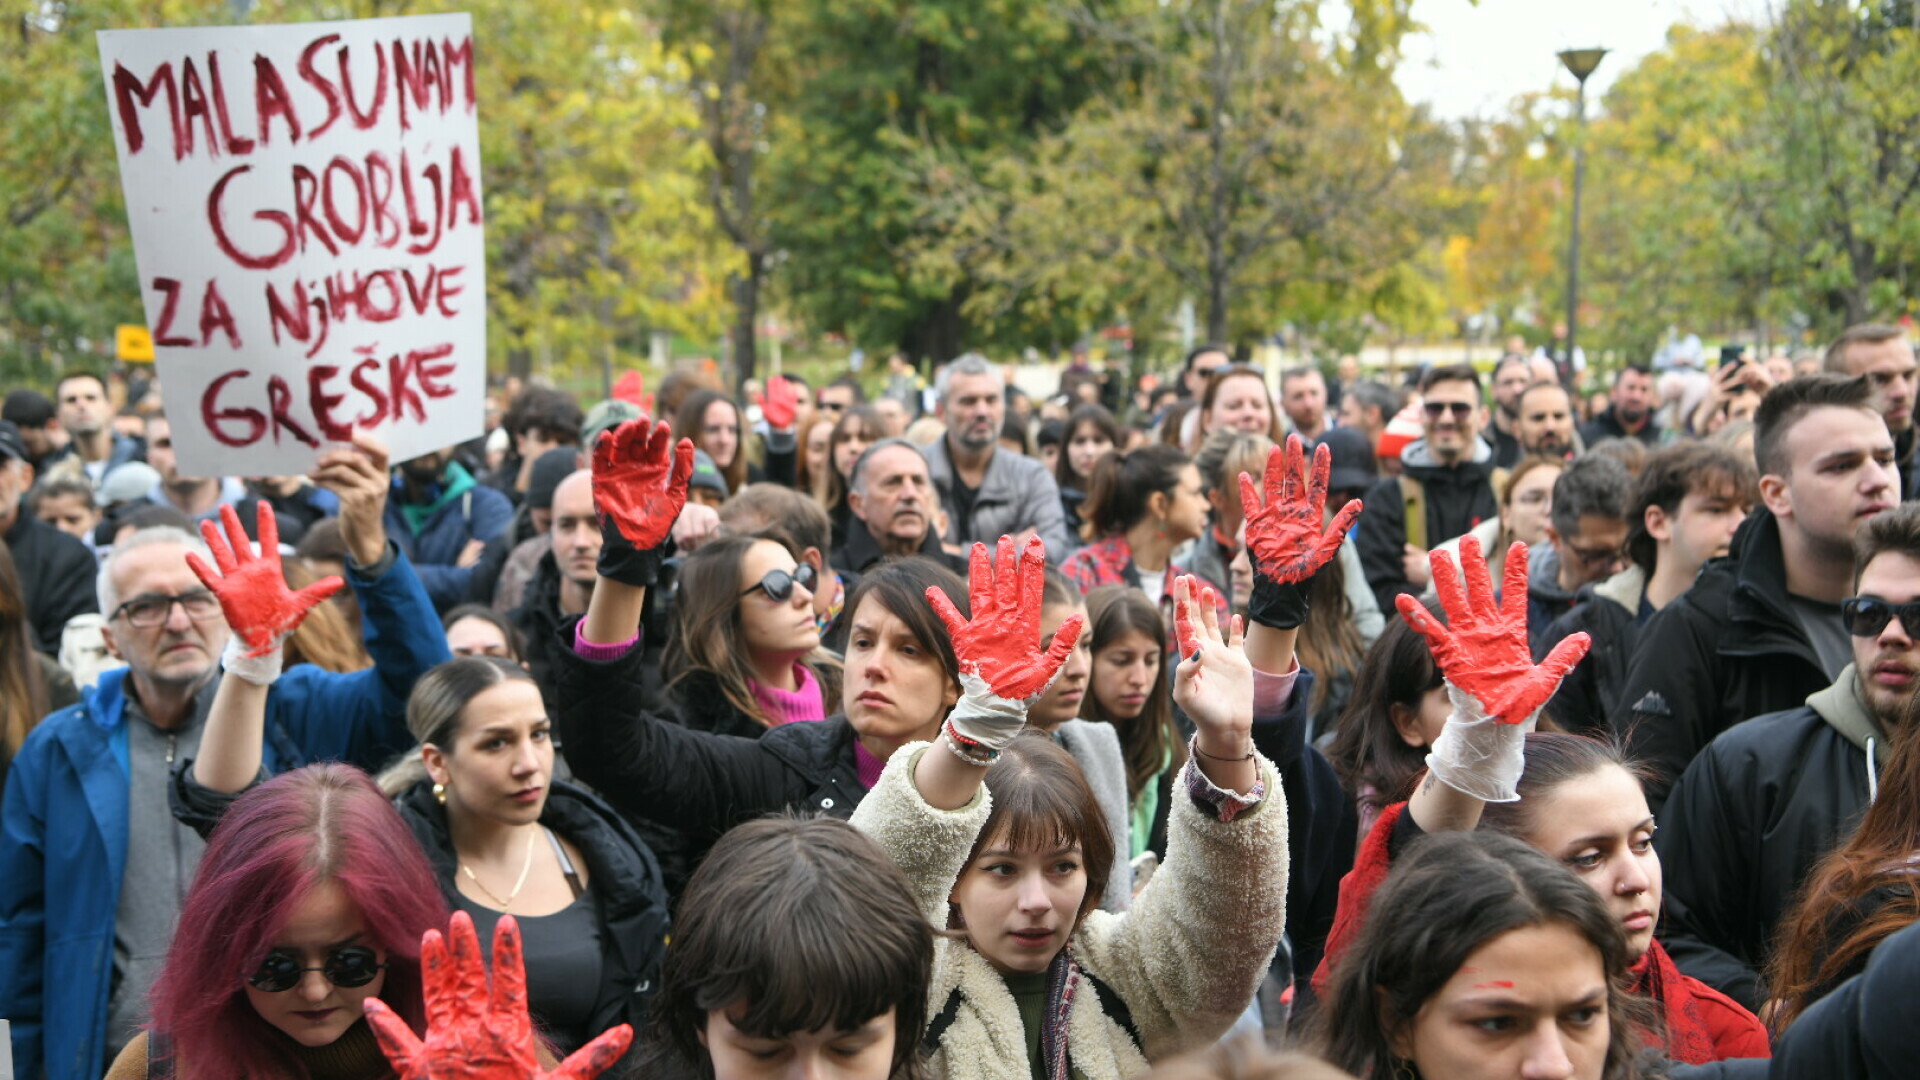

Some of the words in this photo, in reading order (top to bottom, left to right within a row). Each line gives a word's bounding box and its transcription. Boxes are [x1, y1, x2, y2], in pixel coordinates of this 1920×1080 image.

[113, 50, 302, 161] MALA
[297, 34, 388, 140] SU
[392, 35, 476, 131] NAM
[152, 277, 242, 349] ZA
[200, 341, 458, 449] GREŠKE
